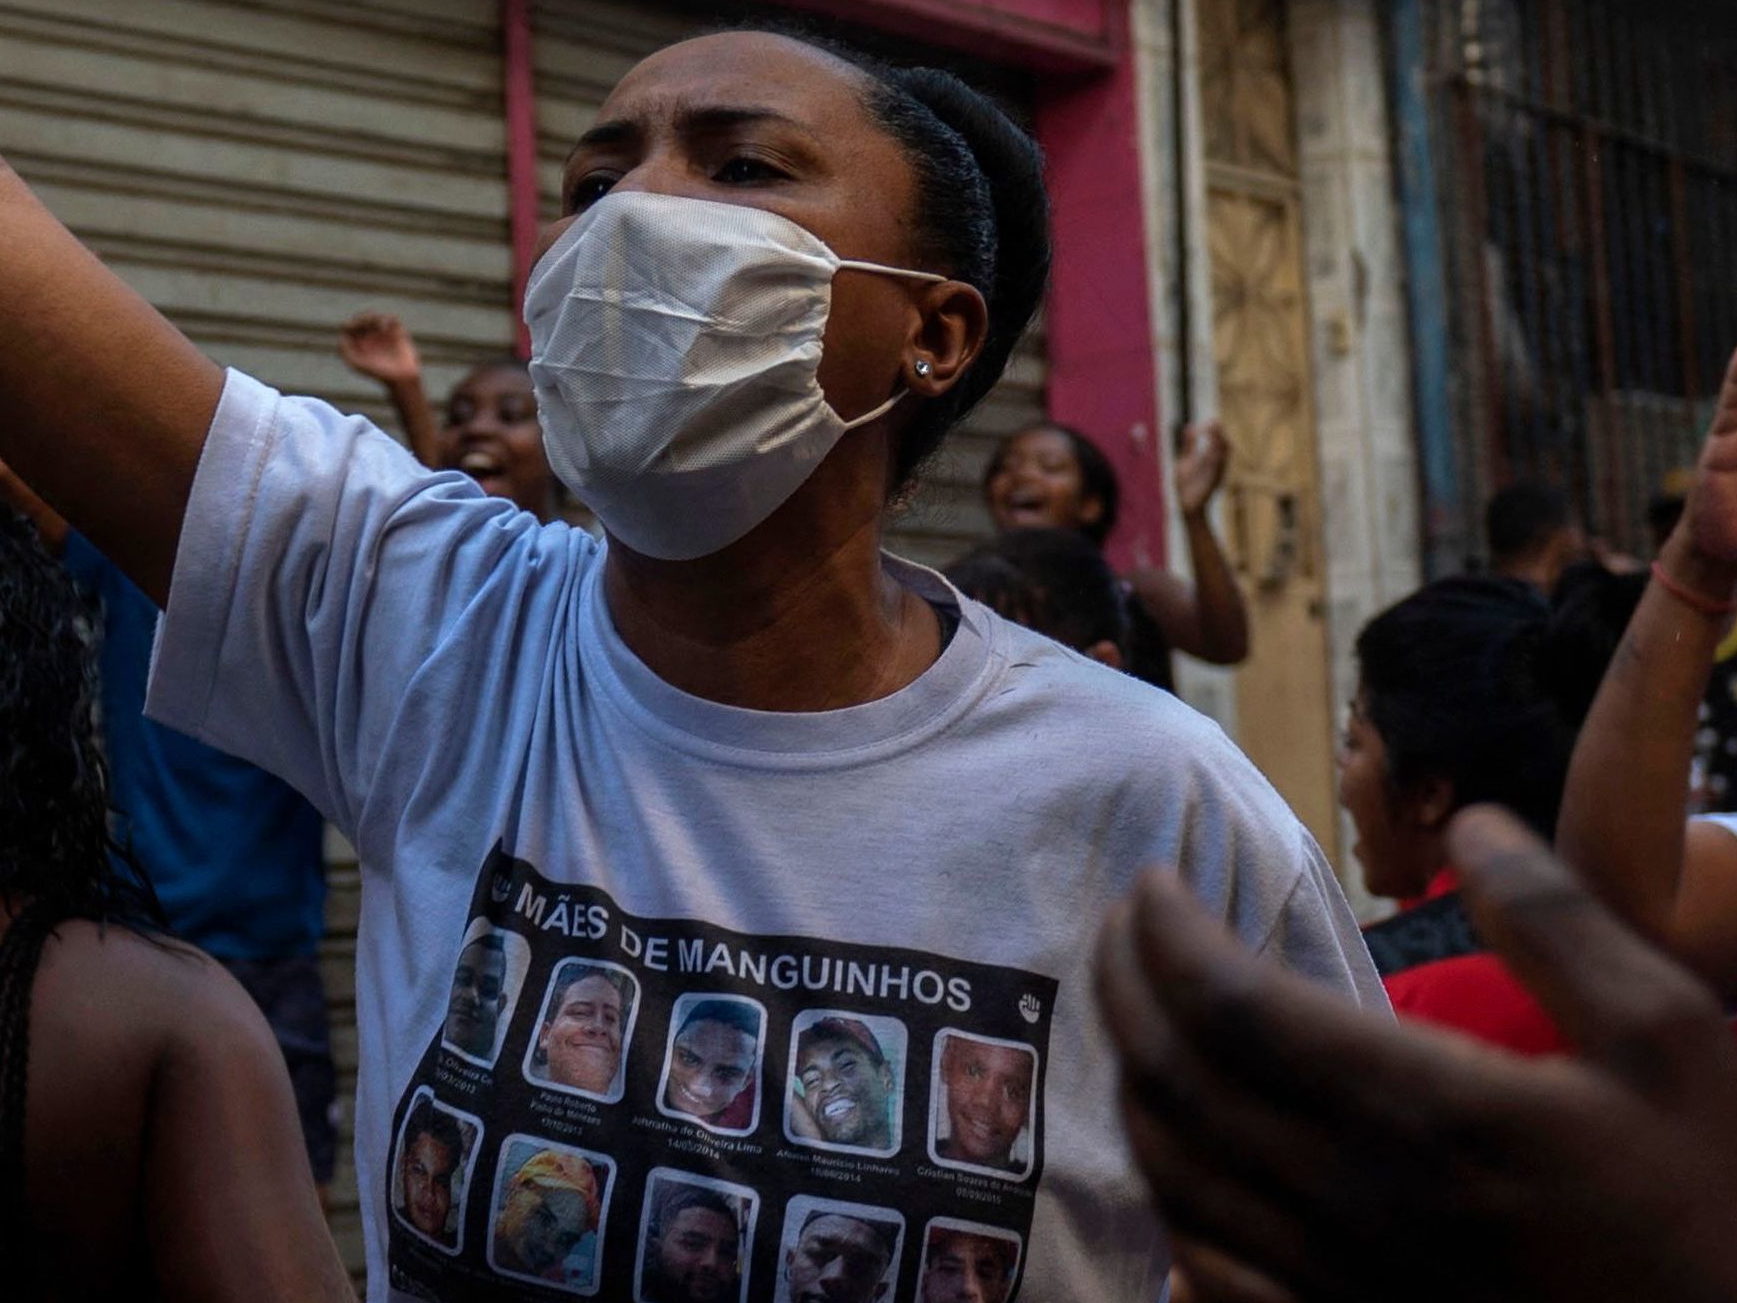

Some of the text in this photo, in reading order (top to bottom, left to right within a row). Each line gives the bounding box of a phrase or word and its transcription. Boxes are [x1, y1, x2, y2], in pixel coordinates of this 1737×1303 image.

[515, 883, 972, 1012] MÃES DE MANGUINHOS
[736, 1141, 762, 1155] Lima
